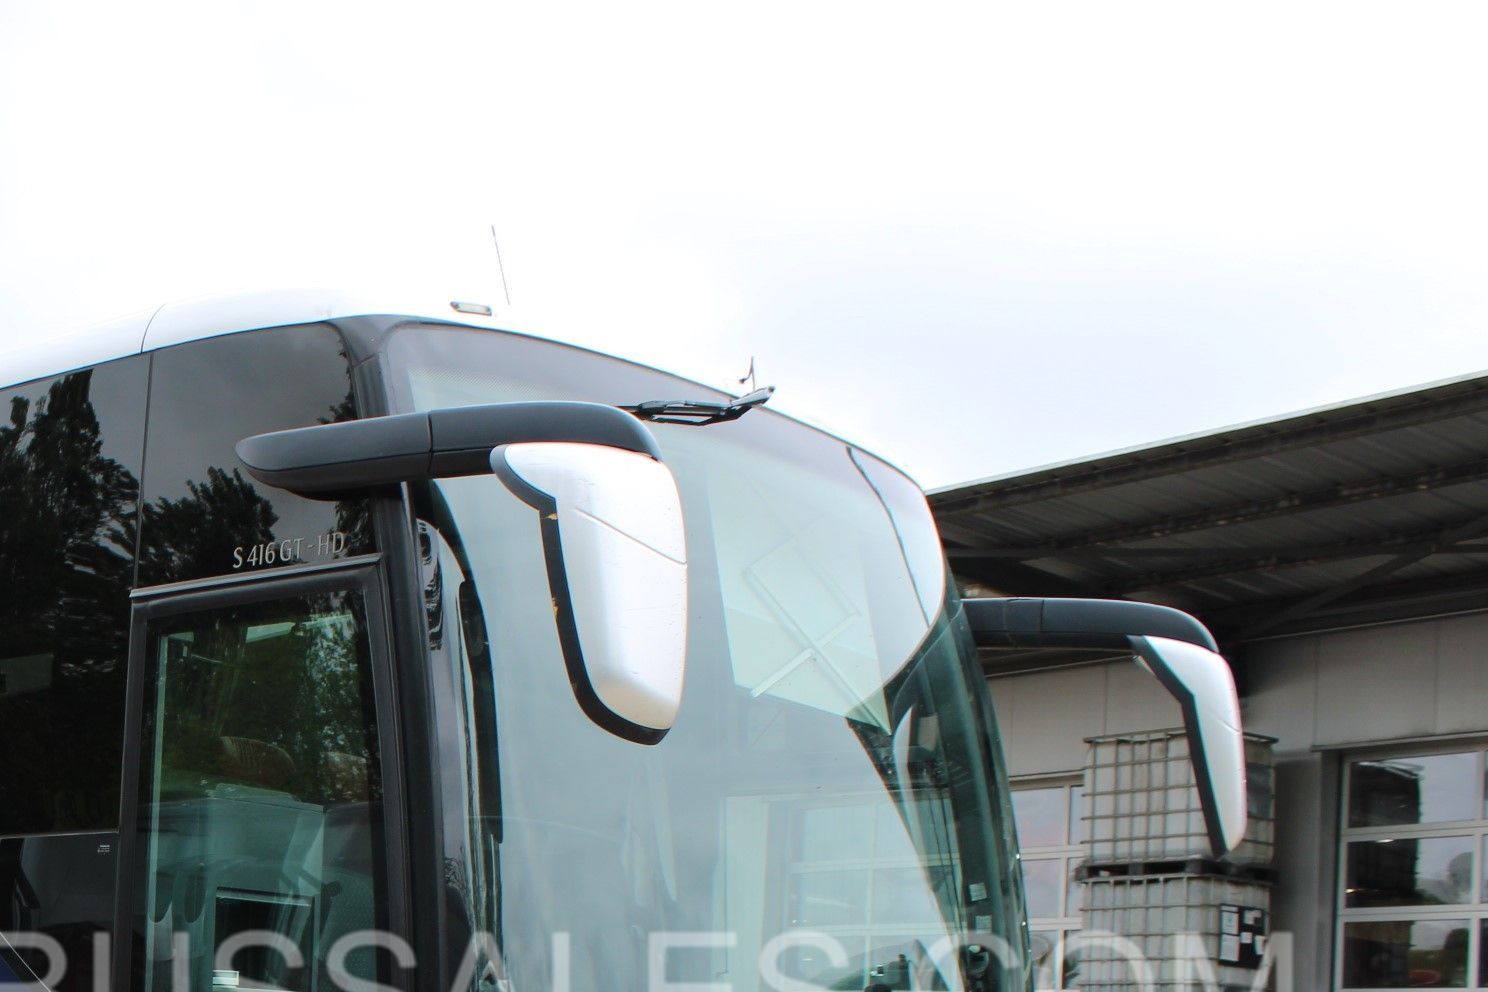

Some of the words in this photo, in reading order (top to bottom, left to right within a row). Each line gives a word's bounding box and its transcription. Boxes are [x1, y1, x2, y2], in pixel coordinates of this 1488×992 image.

[232, 546, 243, 569] S
[246, 541, 276, 567] 416
[279, 537, 305, 562] GT
[317, 531, 345, 556] HD
